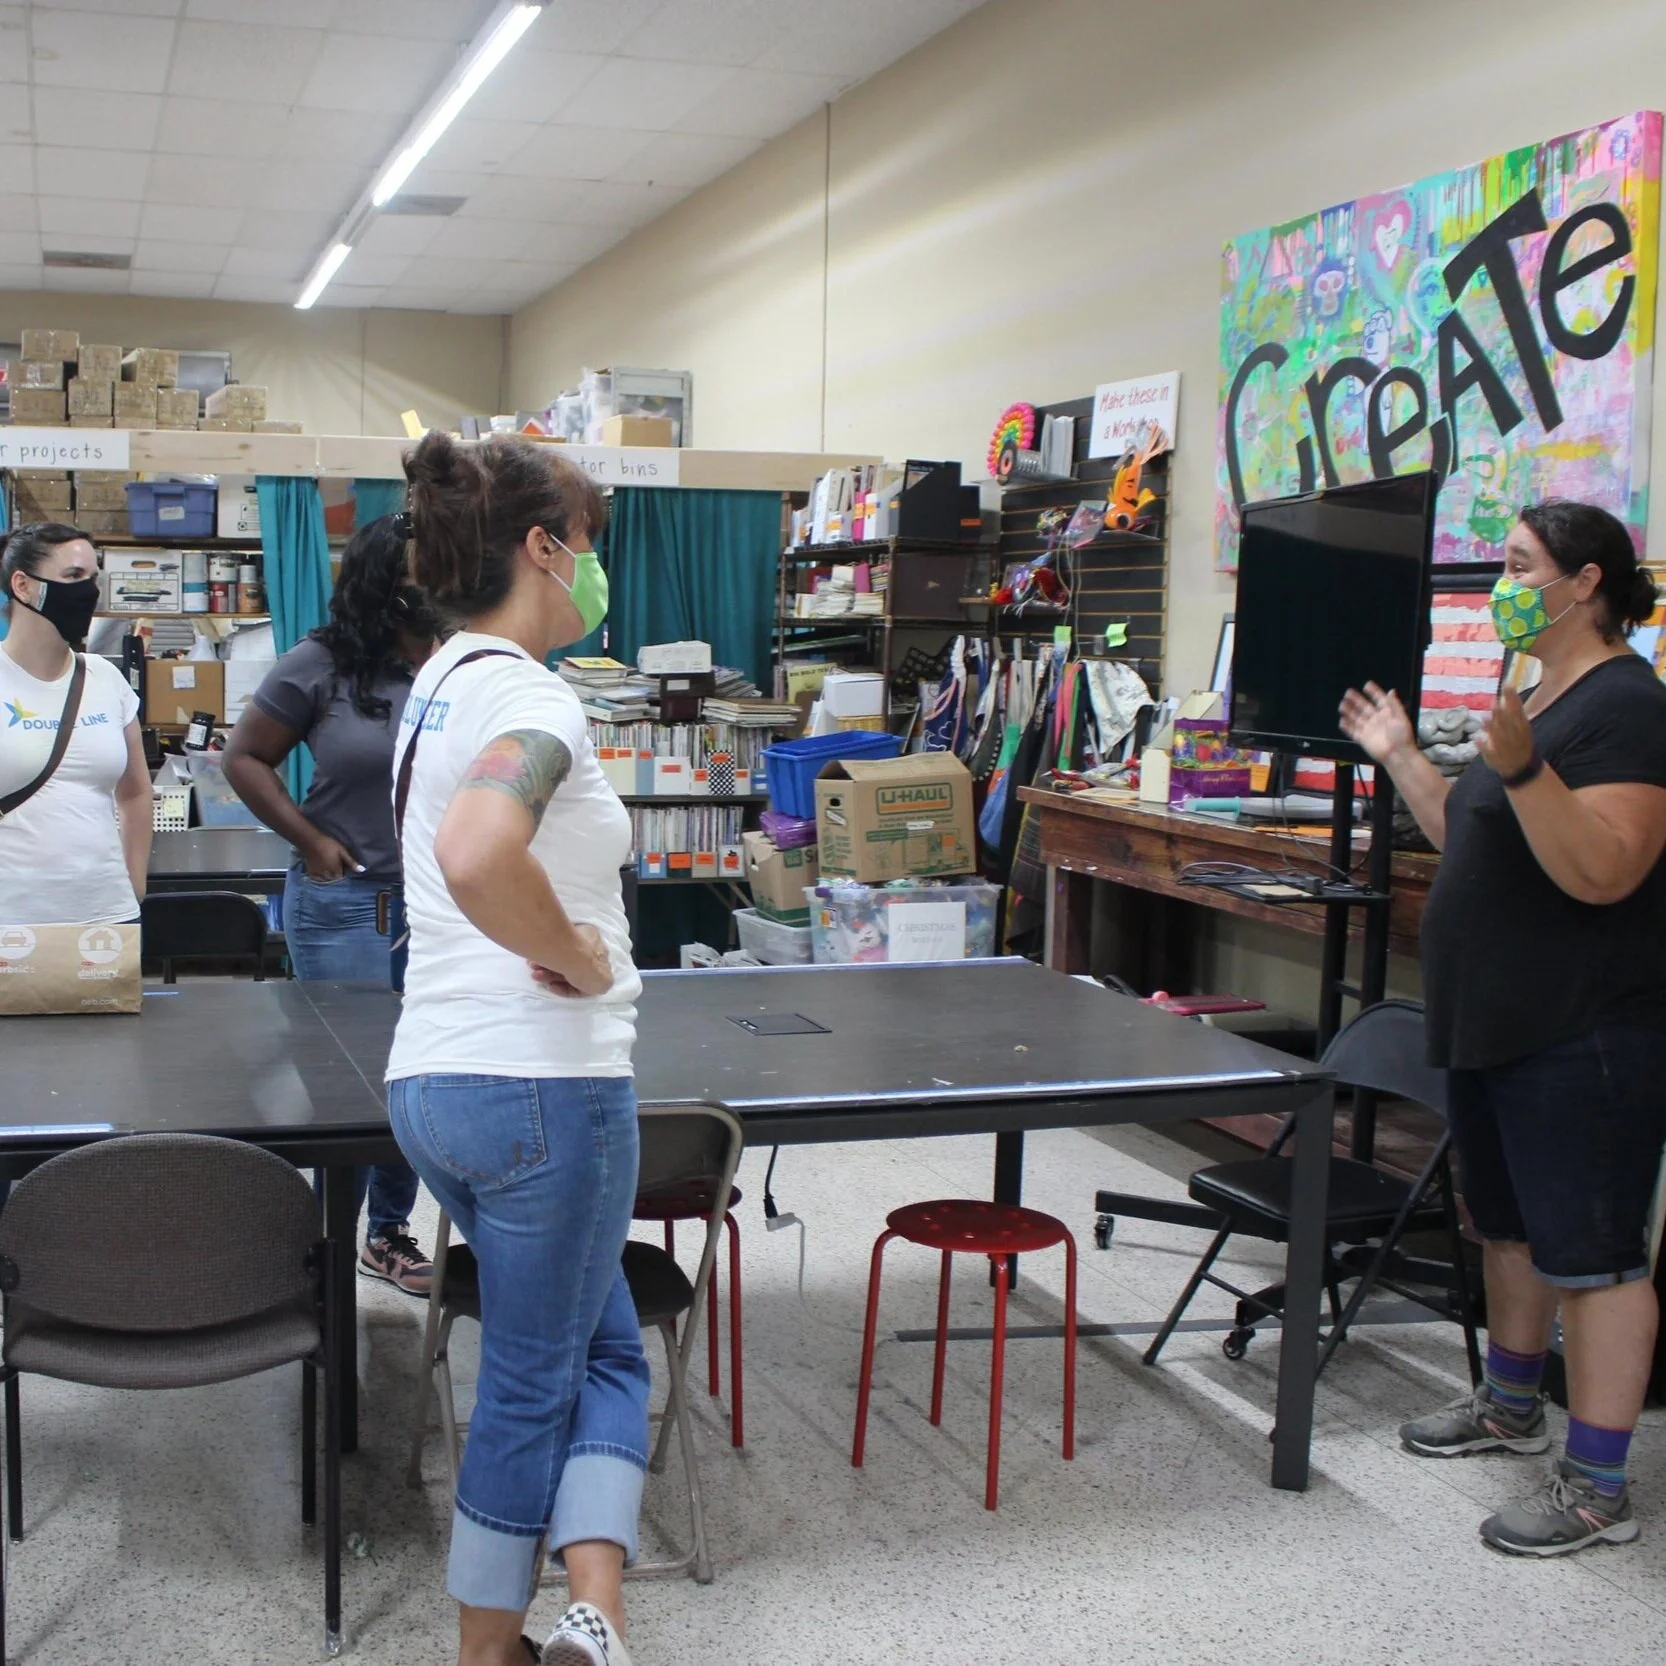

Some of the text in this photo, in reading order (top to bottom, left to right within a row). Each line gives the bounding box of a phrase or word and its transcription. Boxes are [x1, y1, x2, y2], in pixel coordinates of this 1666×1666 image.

[1129, 386, 1158, 407] these
[20, 441, 103, 465] projects
[620, 458, 658, 476] bins
[23, 713, 109, 730] DOUB LINE
[880, 788, 948, 803] U-HAUL
